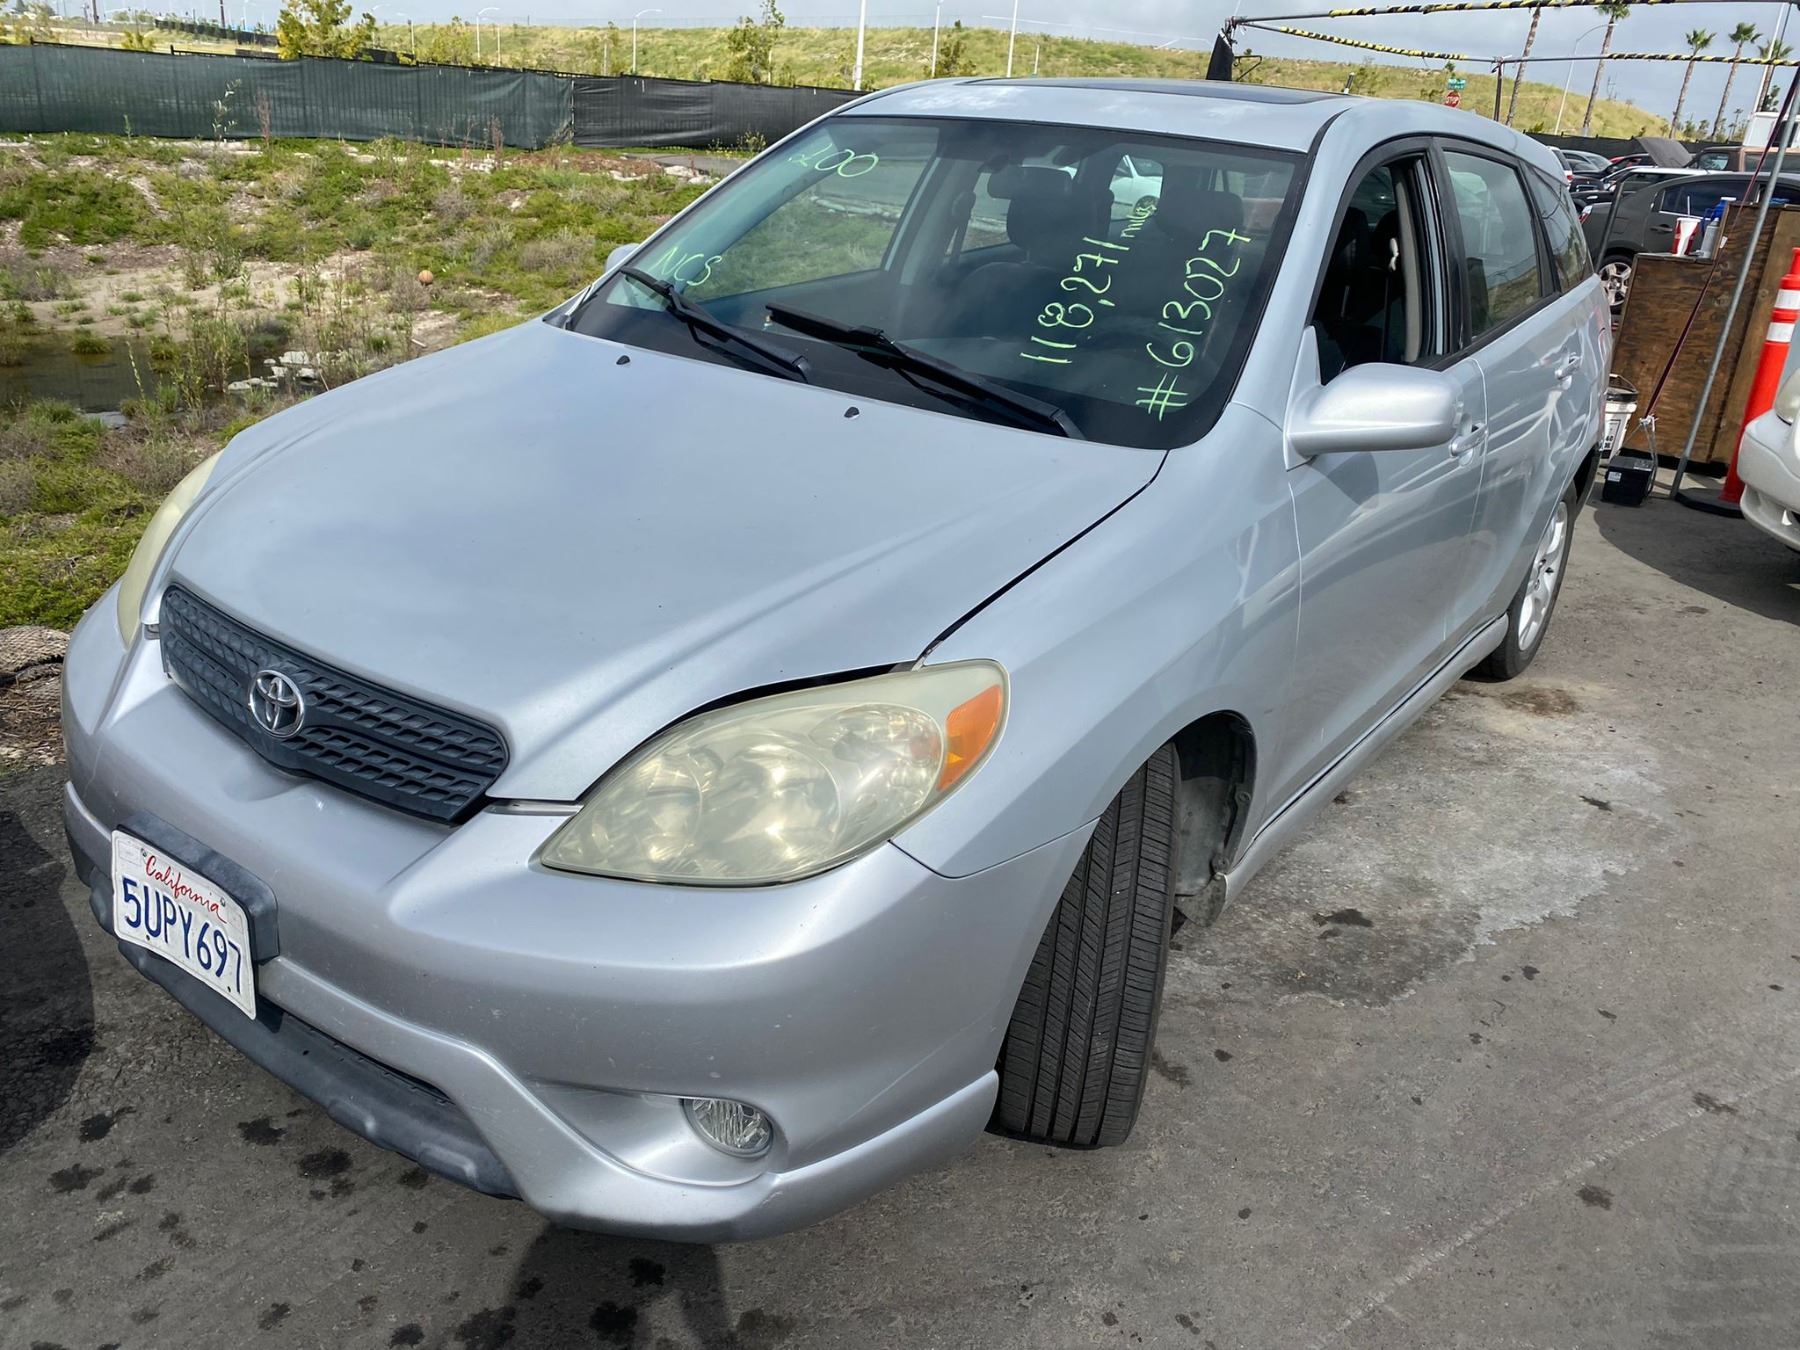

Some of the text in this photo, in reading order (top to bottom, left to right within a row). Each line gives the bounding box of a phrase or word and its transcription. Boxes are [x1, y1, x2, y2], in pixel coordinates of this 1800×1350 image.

[648, 246, 722, 286] NCS
[1020, 236, 1130, 364] 118,271
[122, 877, 242, 994] 5UPY697
[145, 855, 227, 925] California
